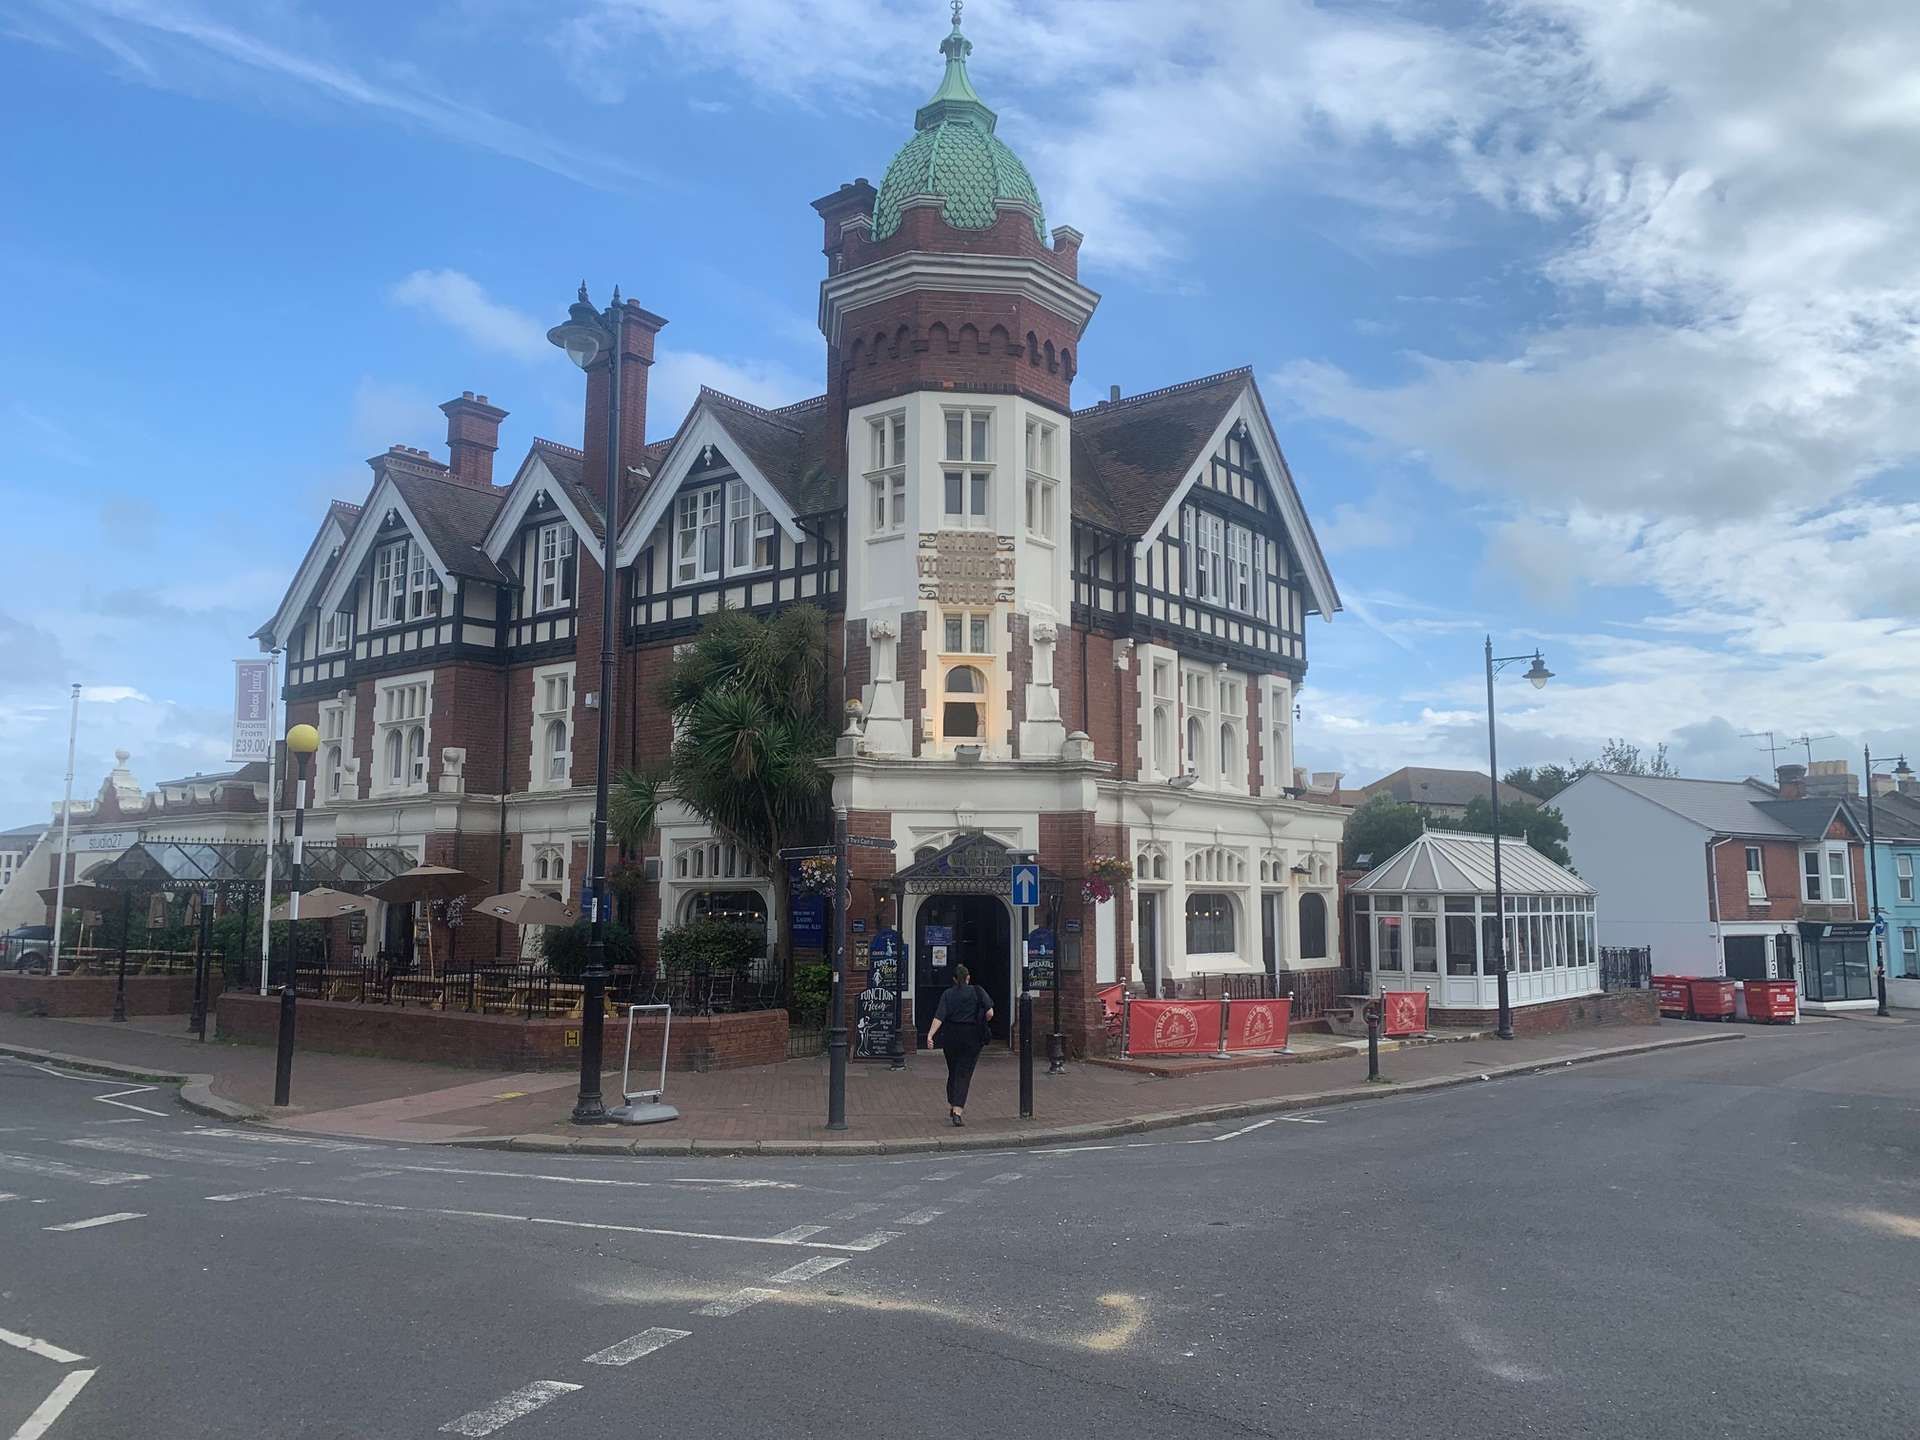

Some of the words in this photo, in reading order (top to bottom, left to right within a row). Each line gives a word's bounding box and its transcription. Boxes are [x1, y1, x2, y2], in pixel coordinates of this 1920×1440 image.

[236, 721, 266, 729] Rooms
[240, 729, 263, 737] From
[235, 738, 266, 753] £39.00
[860, 988, 894, 1001] FUNCTION
[566, 1032, 578, 1045] H
